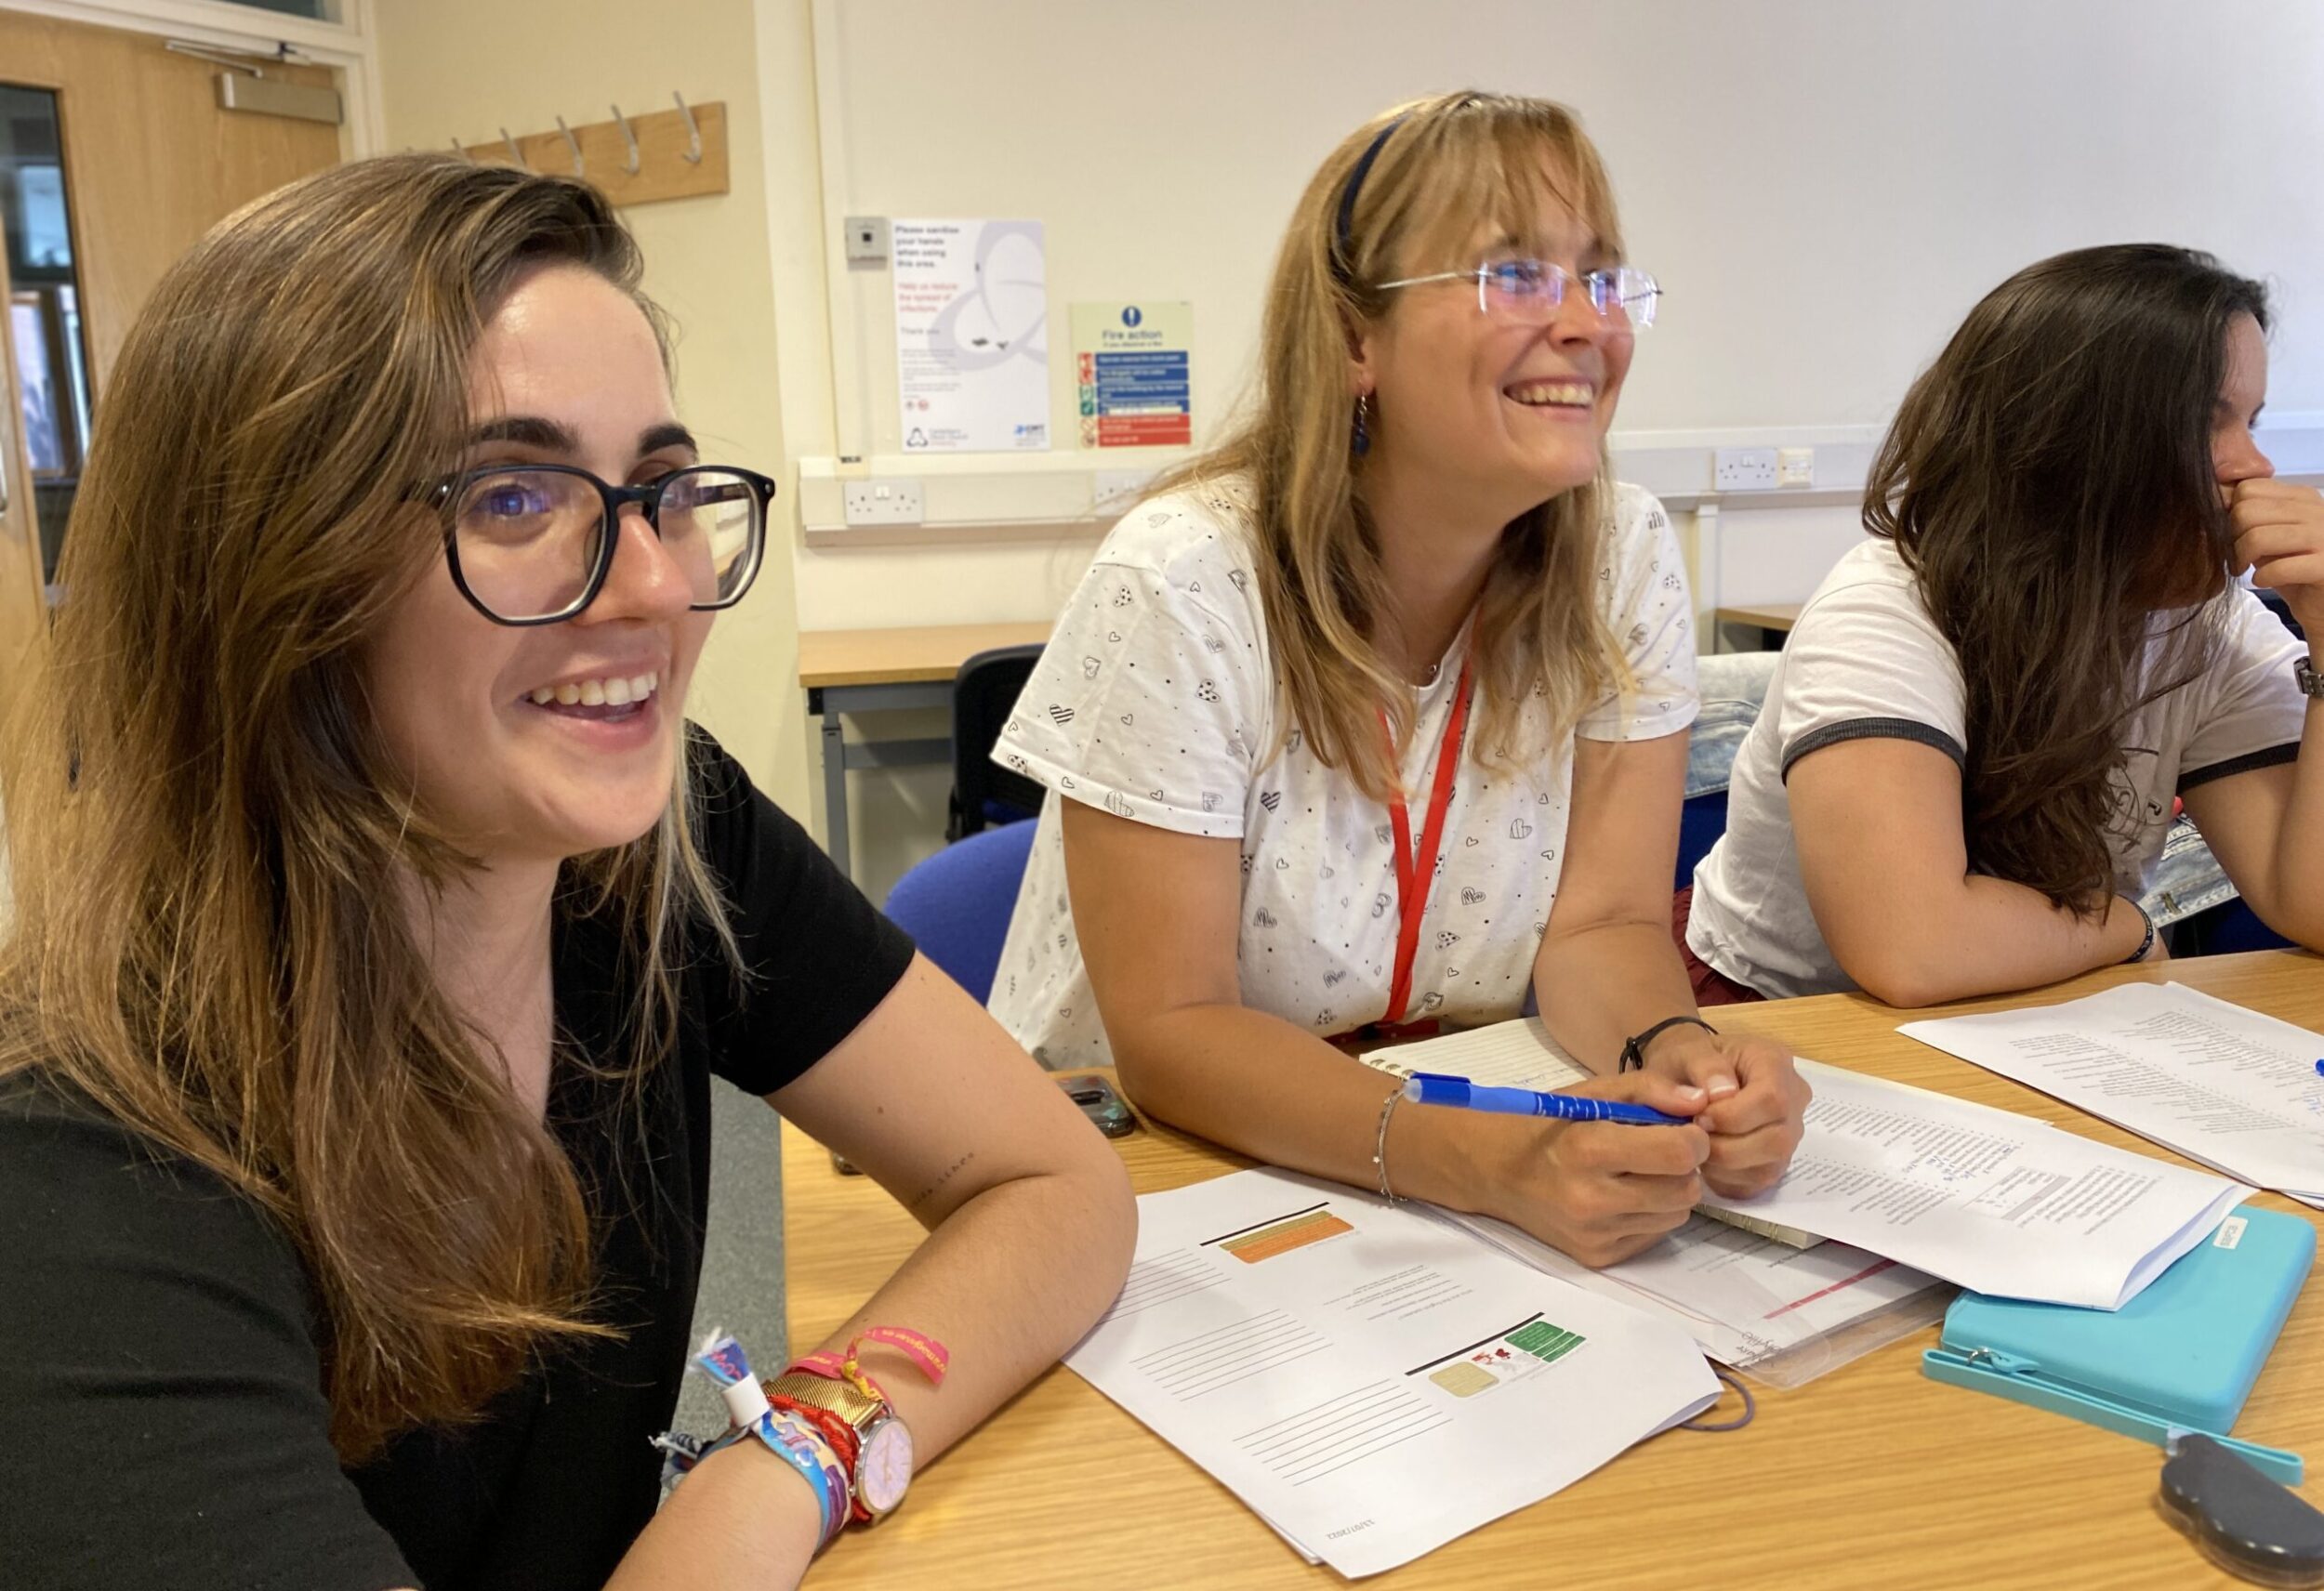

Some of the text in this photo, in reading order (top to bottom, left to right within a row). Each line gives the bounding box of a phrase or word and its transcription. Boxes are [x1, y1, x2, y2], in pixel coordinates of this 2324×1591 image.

[922, 250, 946, 258] using
[898, 283, 918, 291] Help
[914, 294, 941, 302] spread
[1103, 329, 1163, 340] Fire action
